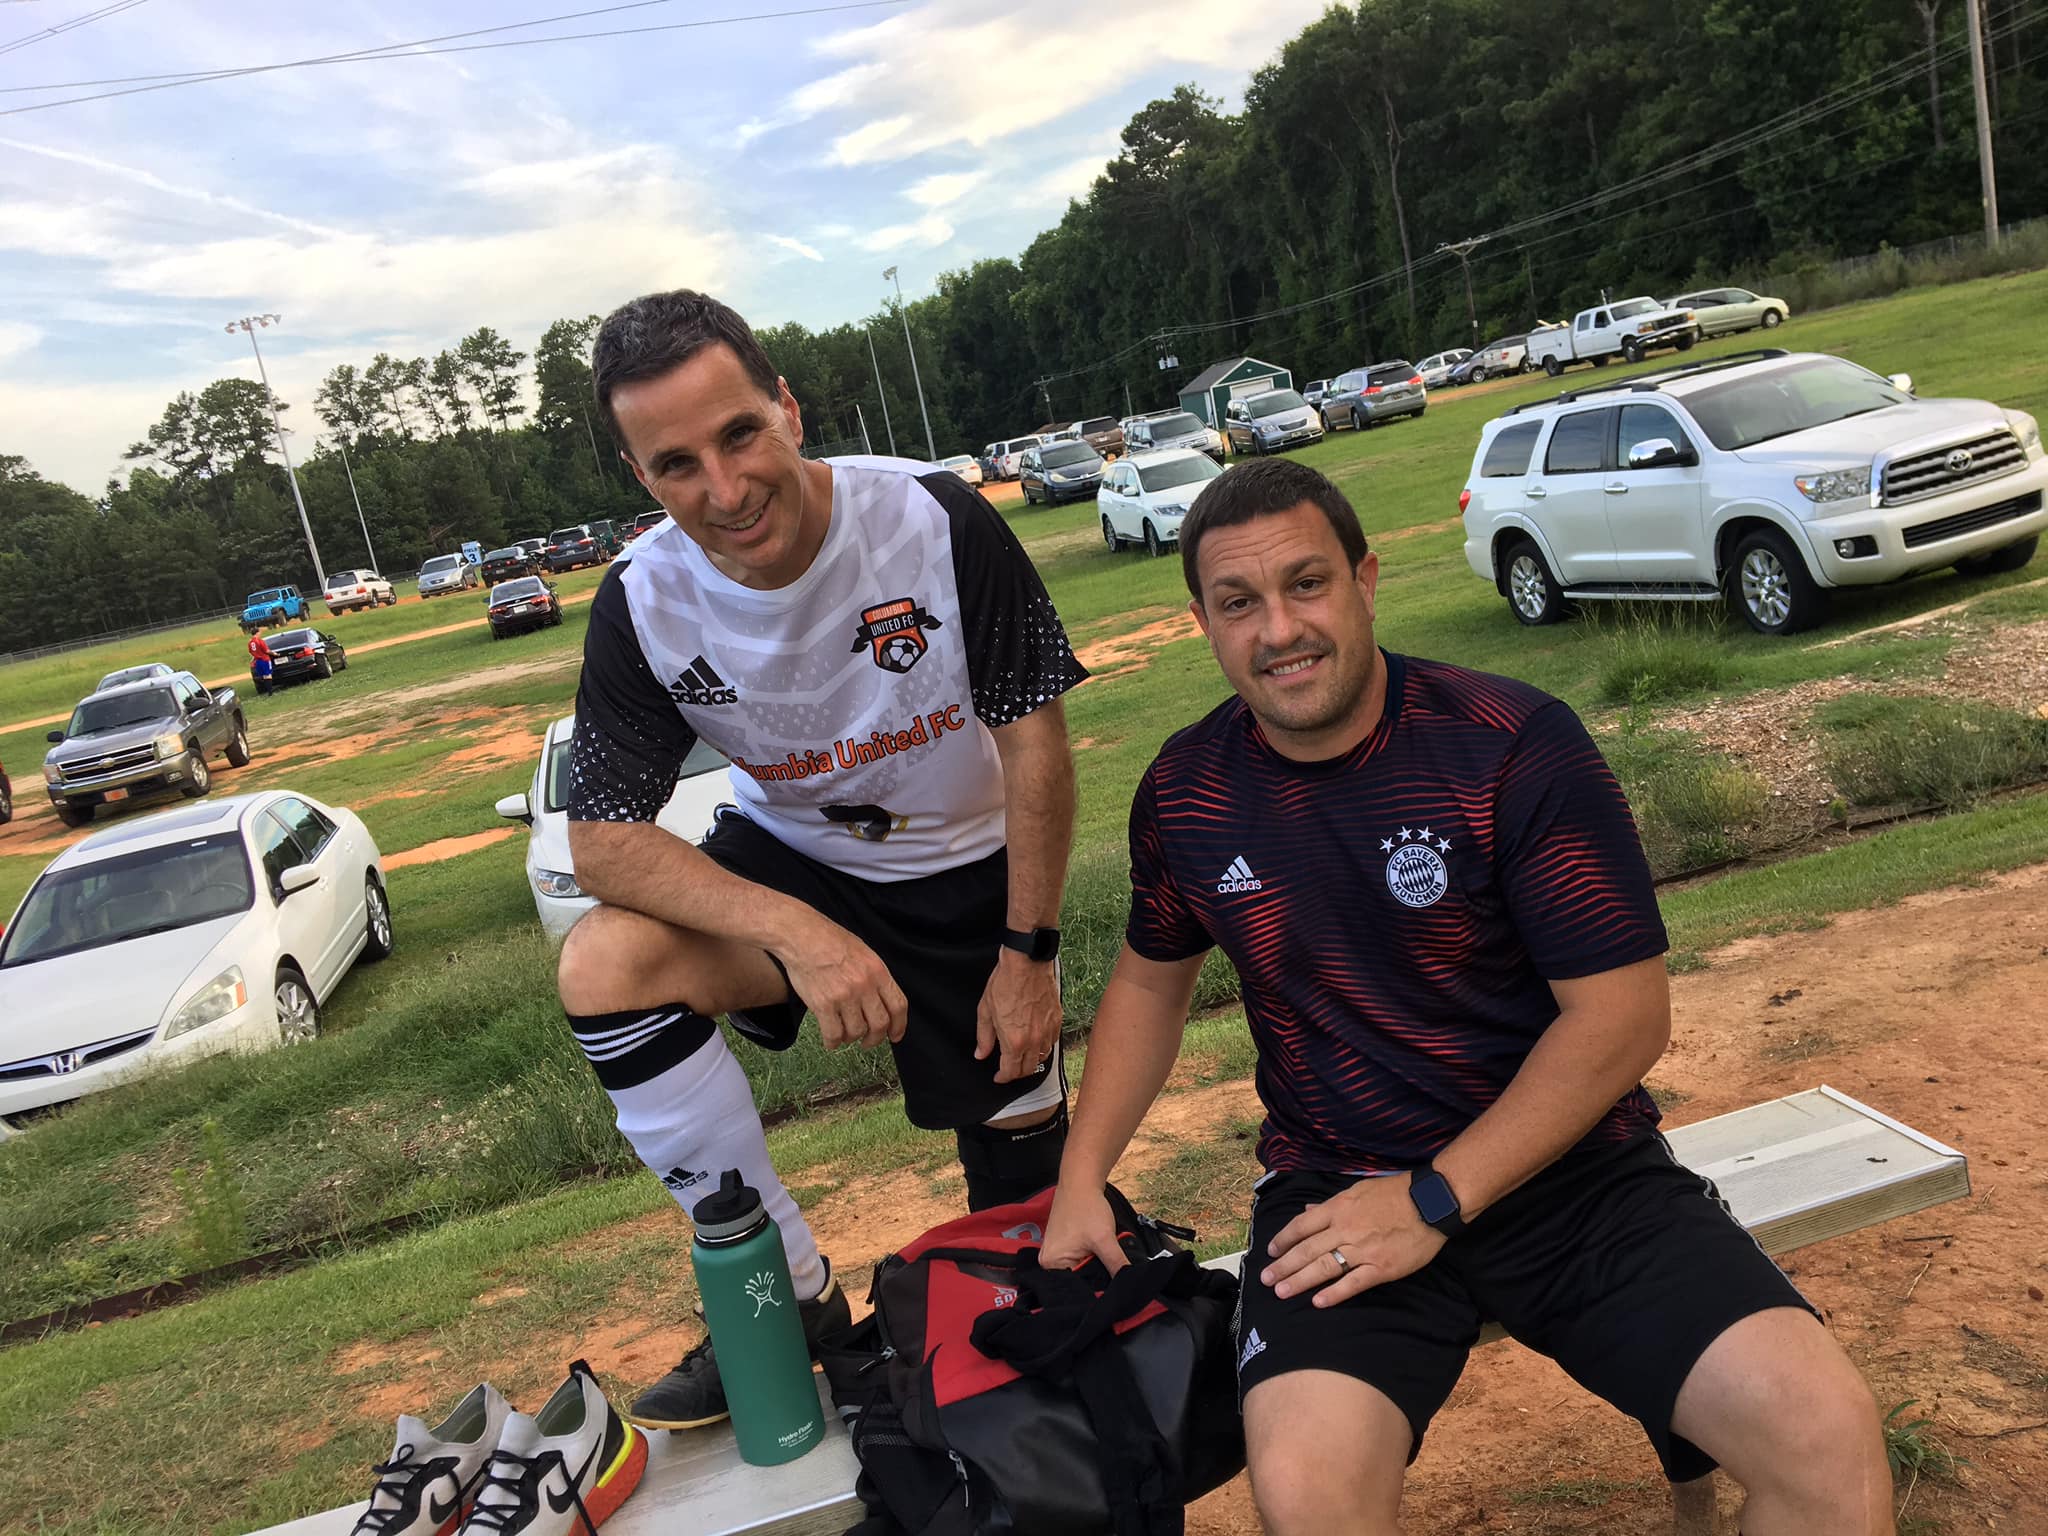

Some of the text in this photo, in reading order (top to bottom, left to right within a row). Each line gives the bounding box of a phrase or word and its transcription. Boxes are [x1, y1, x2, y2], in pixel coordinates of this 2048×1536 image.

[469, 553, 477, 563] 3
[872, 603, 905, 620] COLUMBIA
[870, 614, 915, 636] UNITED FC
[669, 687, 738, 706] adidas
[728, 704, 966, 781] lumbia United FC
[1392, 848, 1441, 872] FC BAYERN
[1217, 877, 1262, 894] adidas
